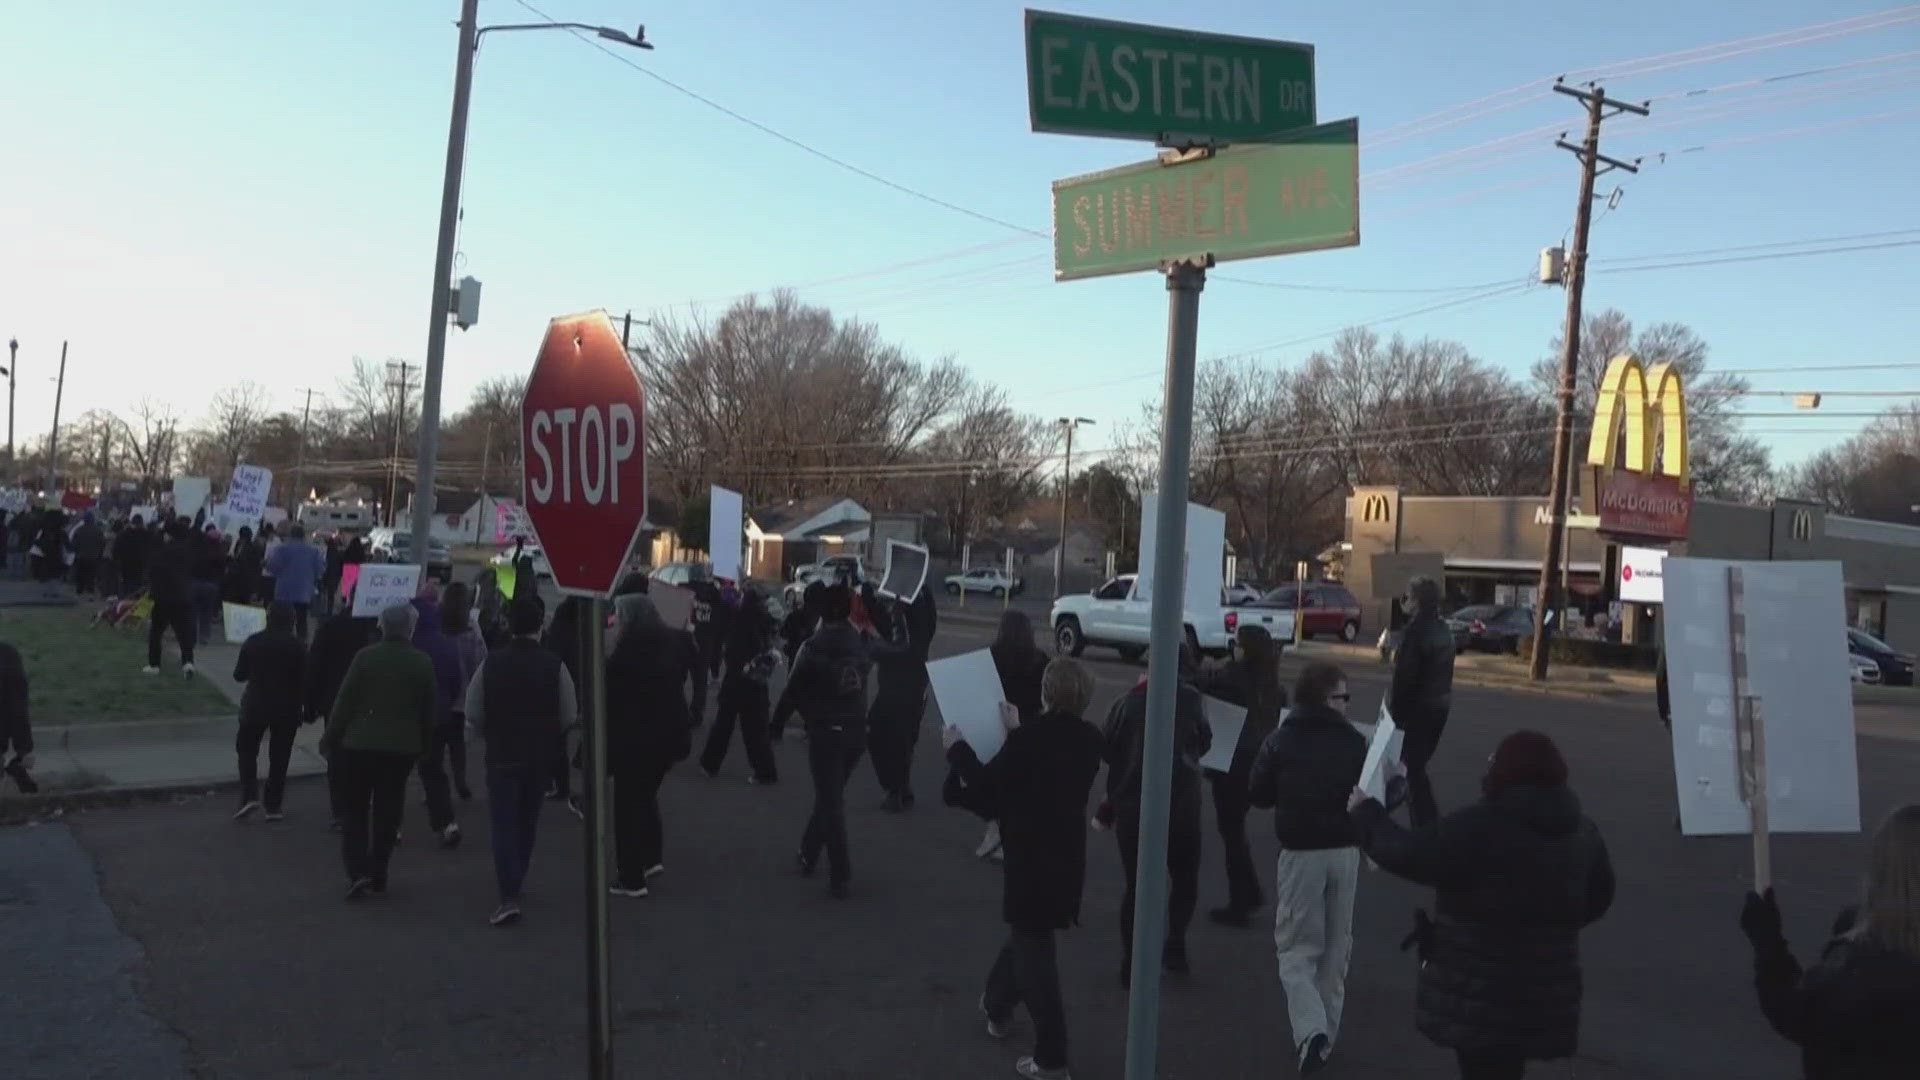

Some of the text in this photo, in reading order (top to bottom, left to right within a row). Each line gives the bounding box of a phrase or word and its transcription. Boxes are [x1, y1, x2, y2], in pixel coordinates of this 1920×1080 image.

[1041, 37, 1307, 123] EASTERN DR
[1072, 165, 1250, 258] SUMMER
[531, 403, 636, 505] STOP
[1602, 489, 1689, 518] McDonald's
